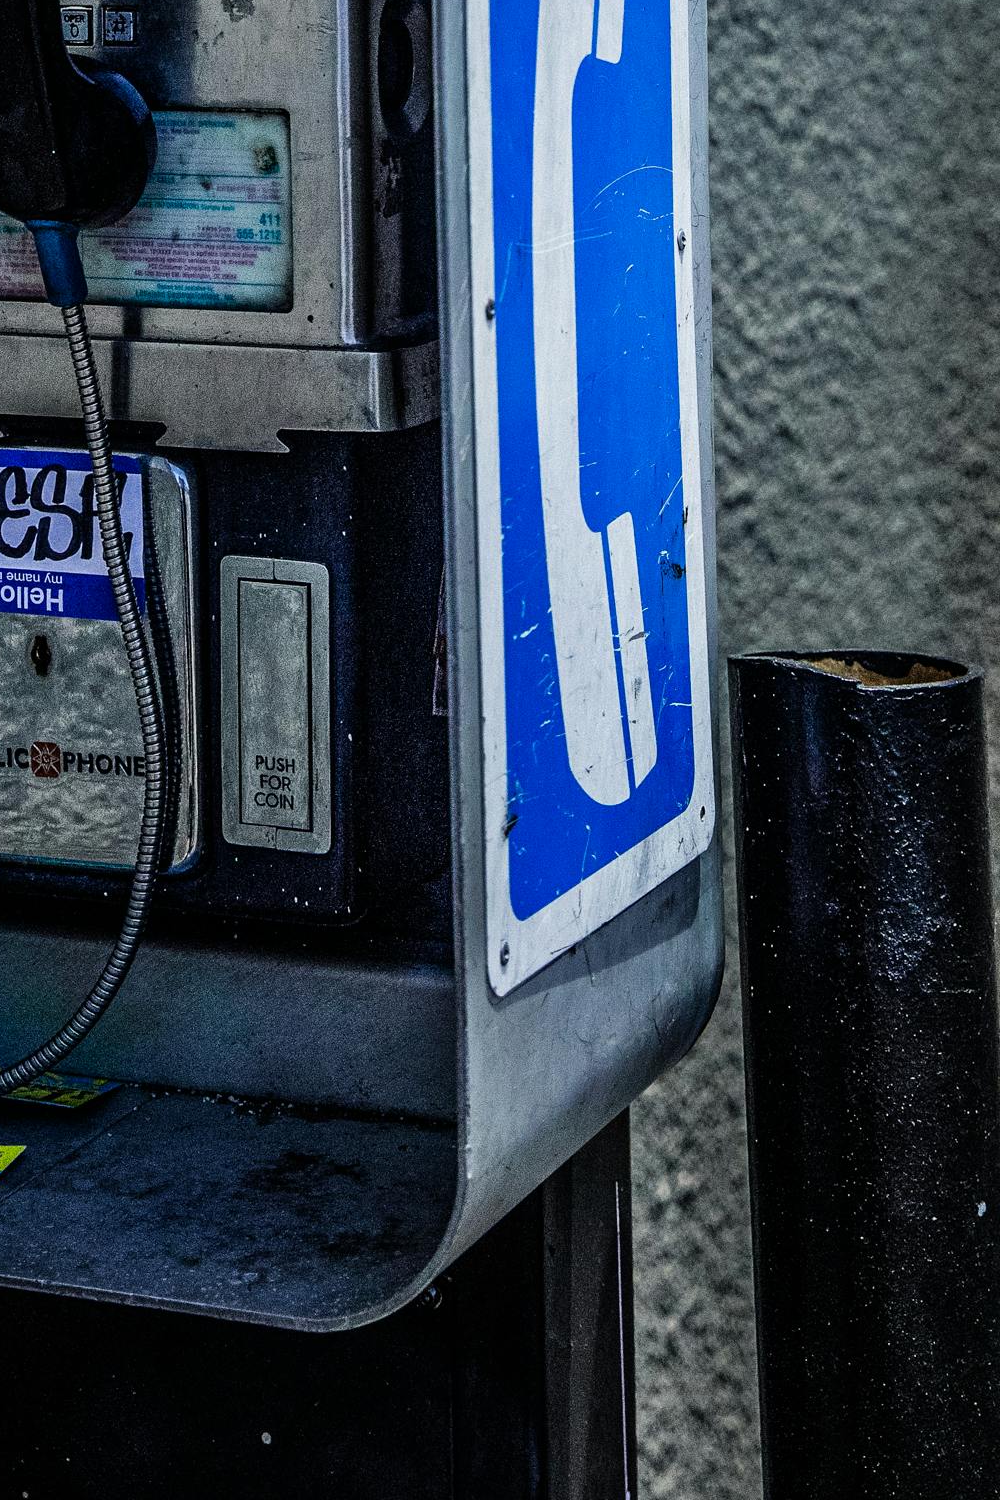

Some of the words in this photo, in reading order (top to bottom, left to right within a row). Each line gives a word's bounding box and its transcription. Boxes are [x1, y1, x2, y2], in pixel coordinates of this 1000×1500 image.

[63, 14, 85, 23] OPER
[70, 22, 80, 38] 0
[259, 213, 281, 226] 411
[6, 572, 41, 583] name
[44, 573, 64, 584] my
[0, 585, 64, 612] Hello
[62, 751, 146, 777] PHONE
[255, 755, 296, 774] PUSH
[259, 773, 291, 791] FOR
[254, 791, 295, 810] COIN
